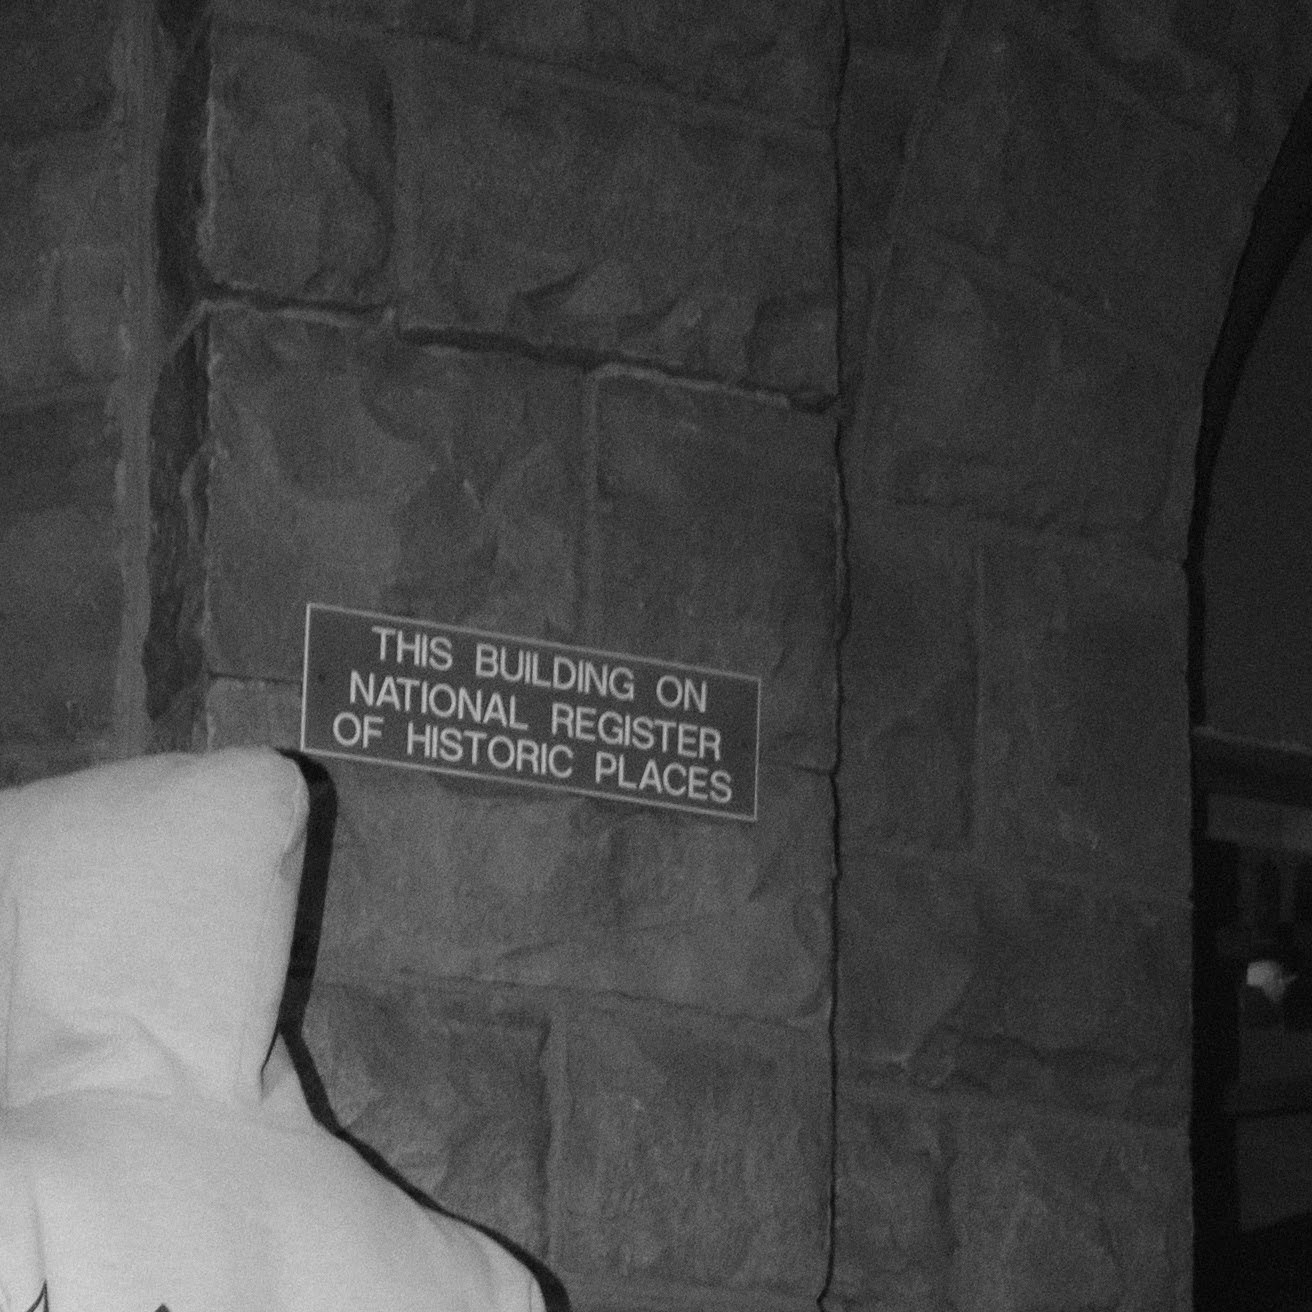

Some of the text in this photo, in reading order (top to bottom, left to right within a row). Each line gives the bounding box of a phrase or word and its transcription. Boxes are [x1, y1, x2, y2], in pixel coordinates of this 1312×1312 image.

[371, 625, 709, 714] THIS BUILDING ON
[332, 712, 733, 804] OF HISTORIC PLACES
[349, 670, 722, 762] NATIONAL REGISTER
